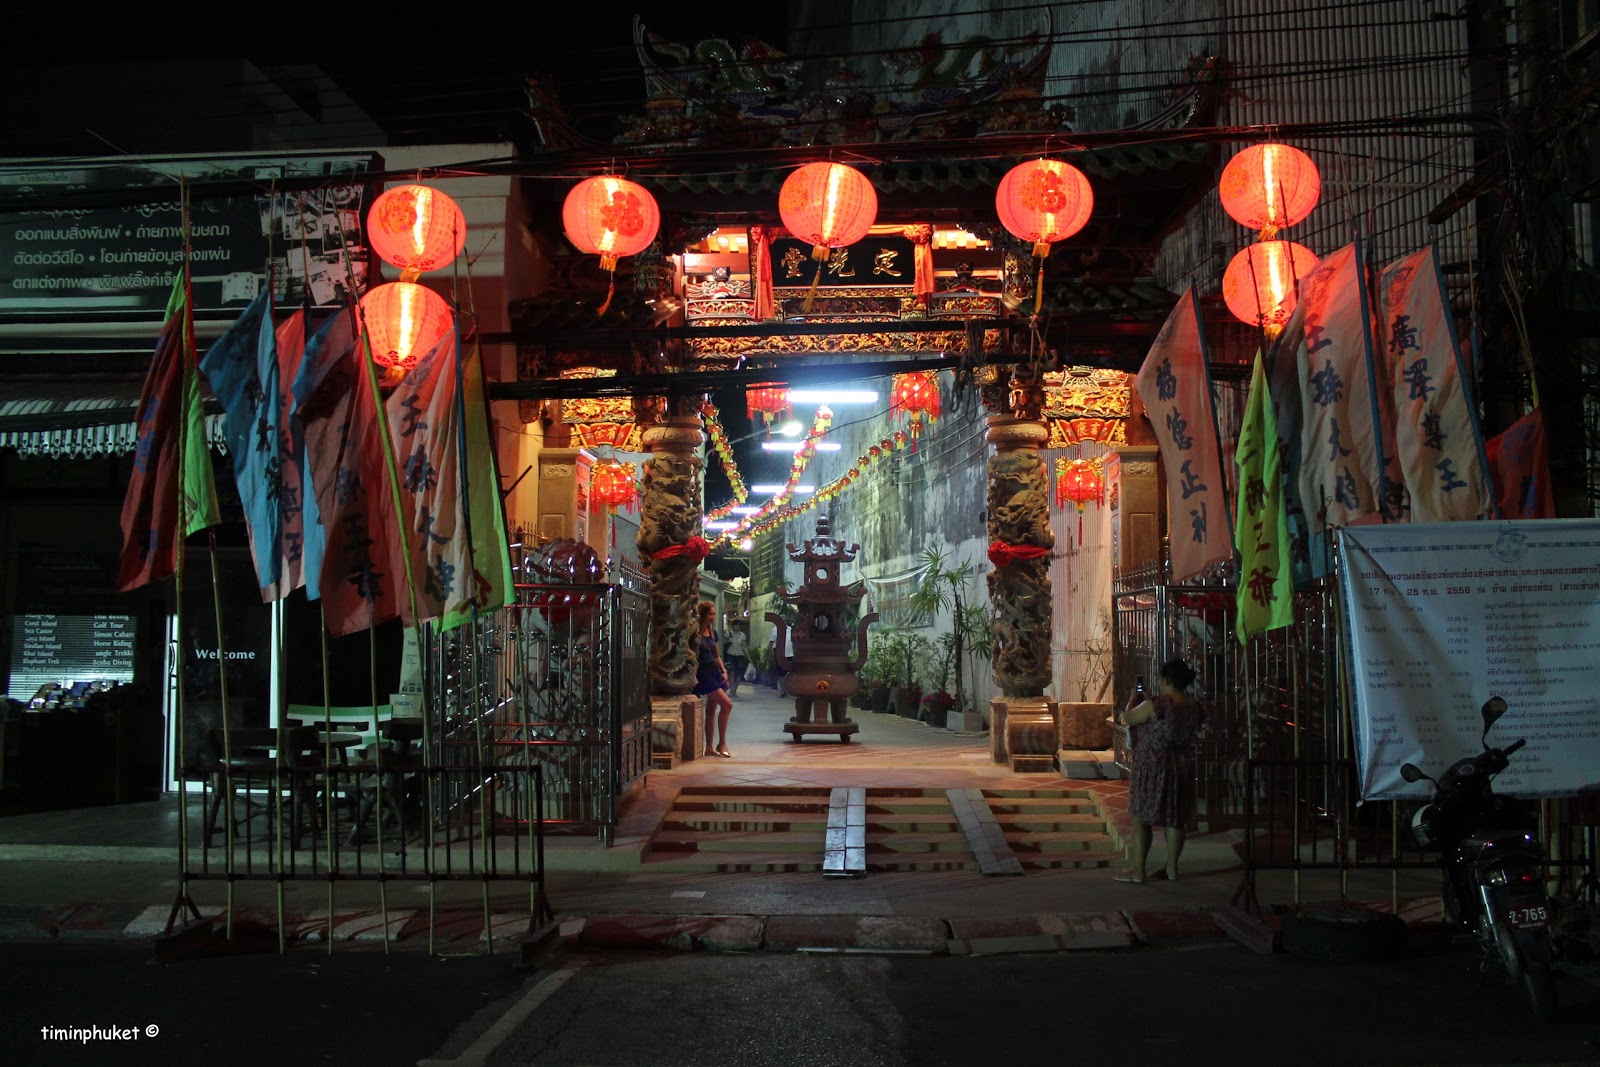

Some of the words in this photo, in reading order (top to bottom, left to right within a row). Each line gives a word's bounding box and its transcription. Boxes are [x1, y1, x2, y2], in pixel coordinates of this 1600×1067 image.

[136, 224, 230, 238] ถ่ายภาพฆษณา
[100, 246, 230, 265] โอนถ่ายข้อมูลงแผ่น
[1406, 588, 1419, 596] 25
